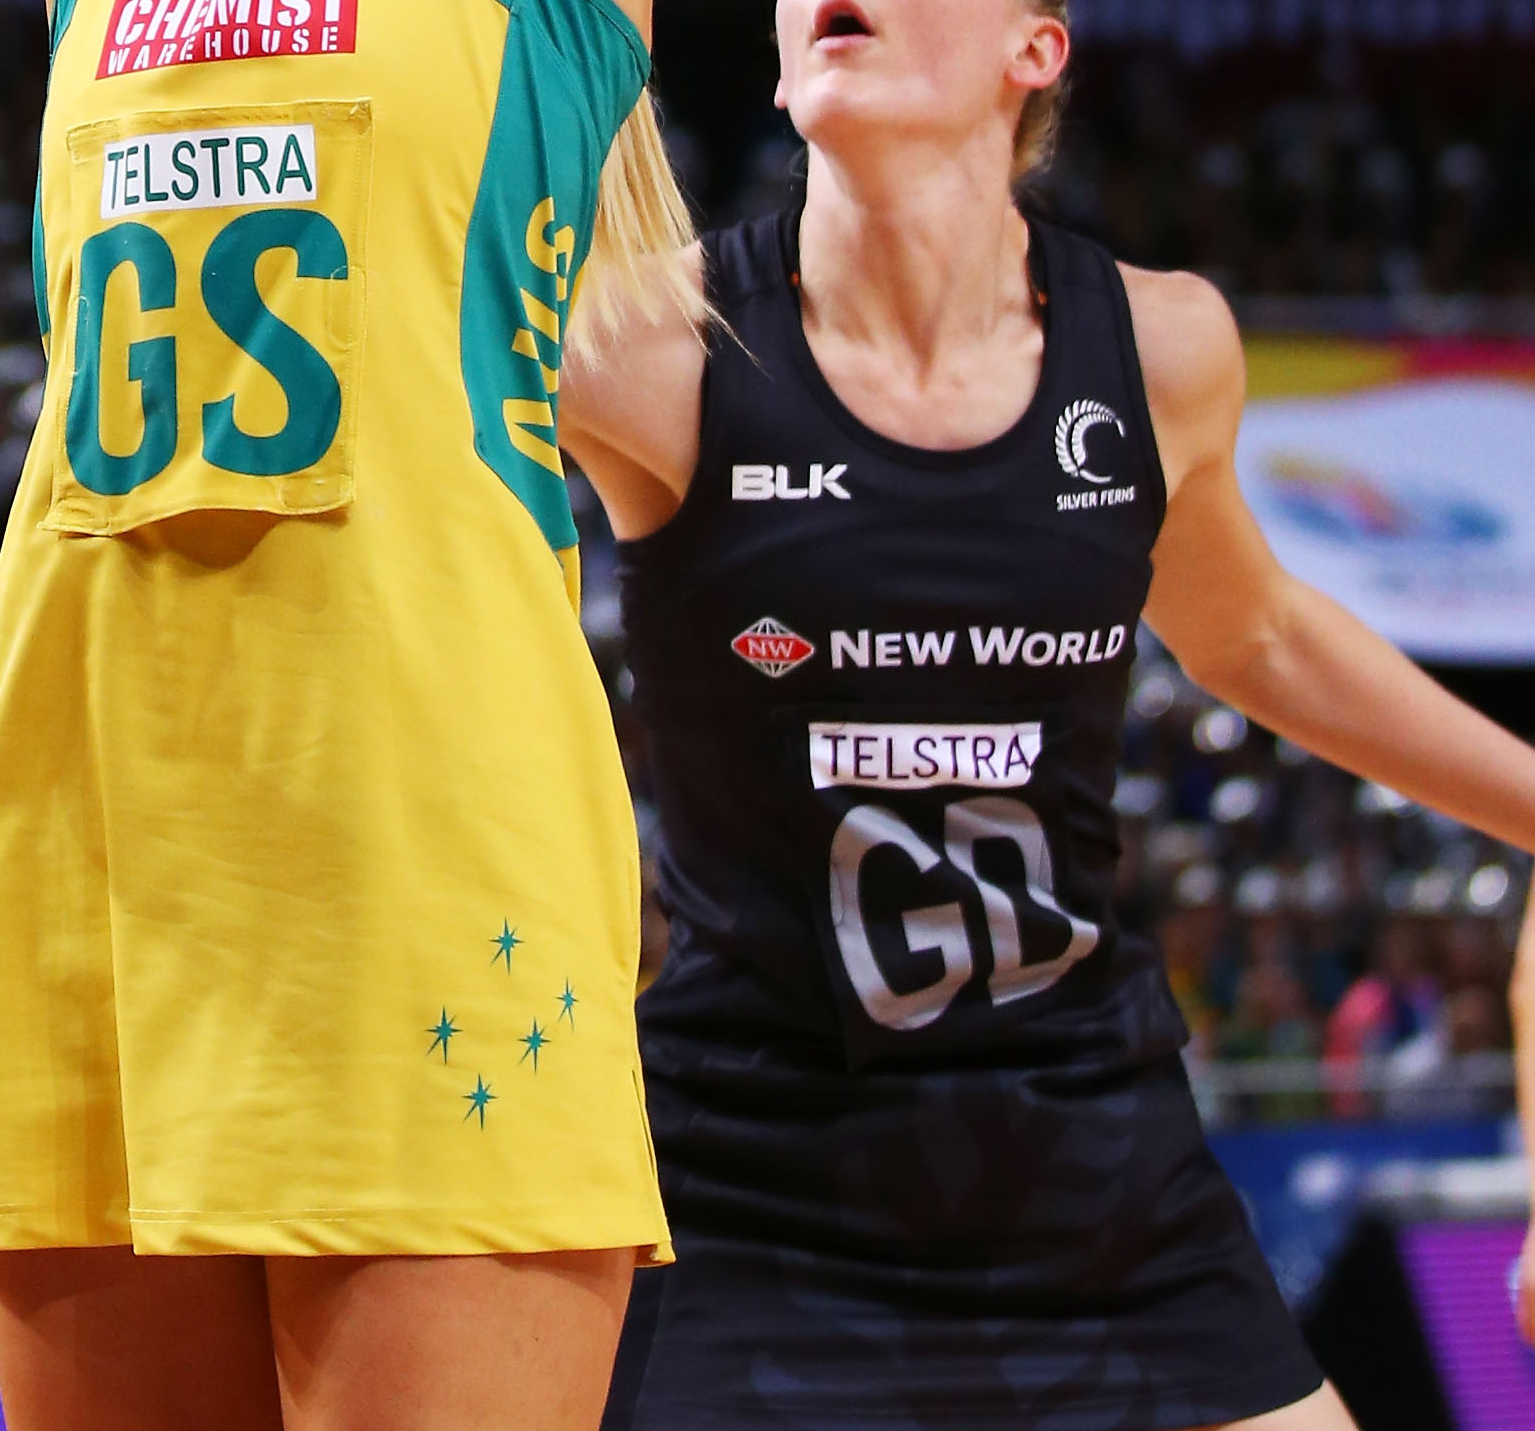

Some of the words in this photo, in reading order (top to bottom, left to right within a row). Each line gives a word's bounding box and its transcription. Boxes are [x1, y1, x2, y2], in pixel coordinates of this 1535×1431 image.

[107, 26, 338, 75] WAREHOUSE
[107, 134, 313, 210] TELSTRA
[65, 209, 348, 495] GS
[732, 463, 851, 500] BLK
[1056, 491, 1098, 512] SILVER
[1100, 485, 1135, 506] FERNS
[747, 635, 794, 657] NW
[830, 630, 956, 669] NEW
[968, 624, 1126, 666] WORLD
[820, 734, 1032, 780] TELSTRA
[830, 797, 1099, 1030] GD
